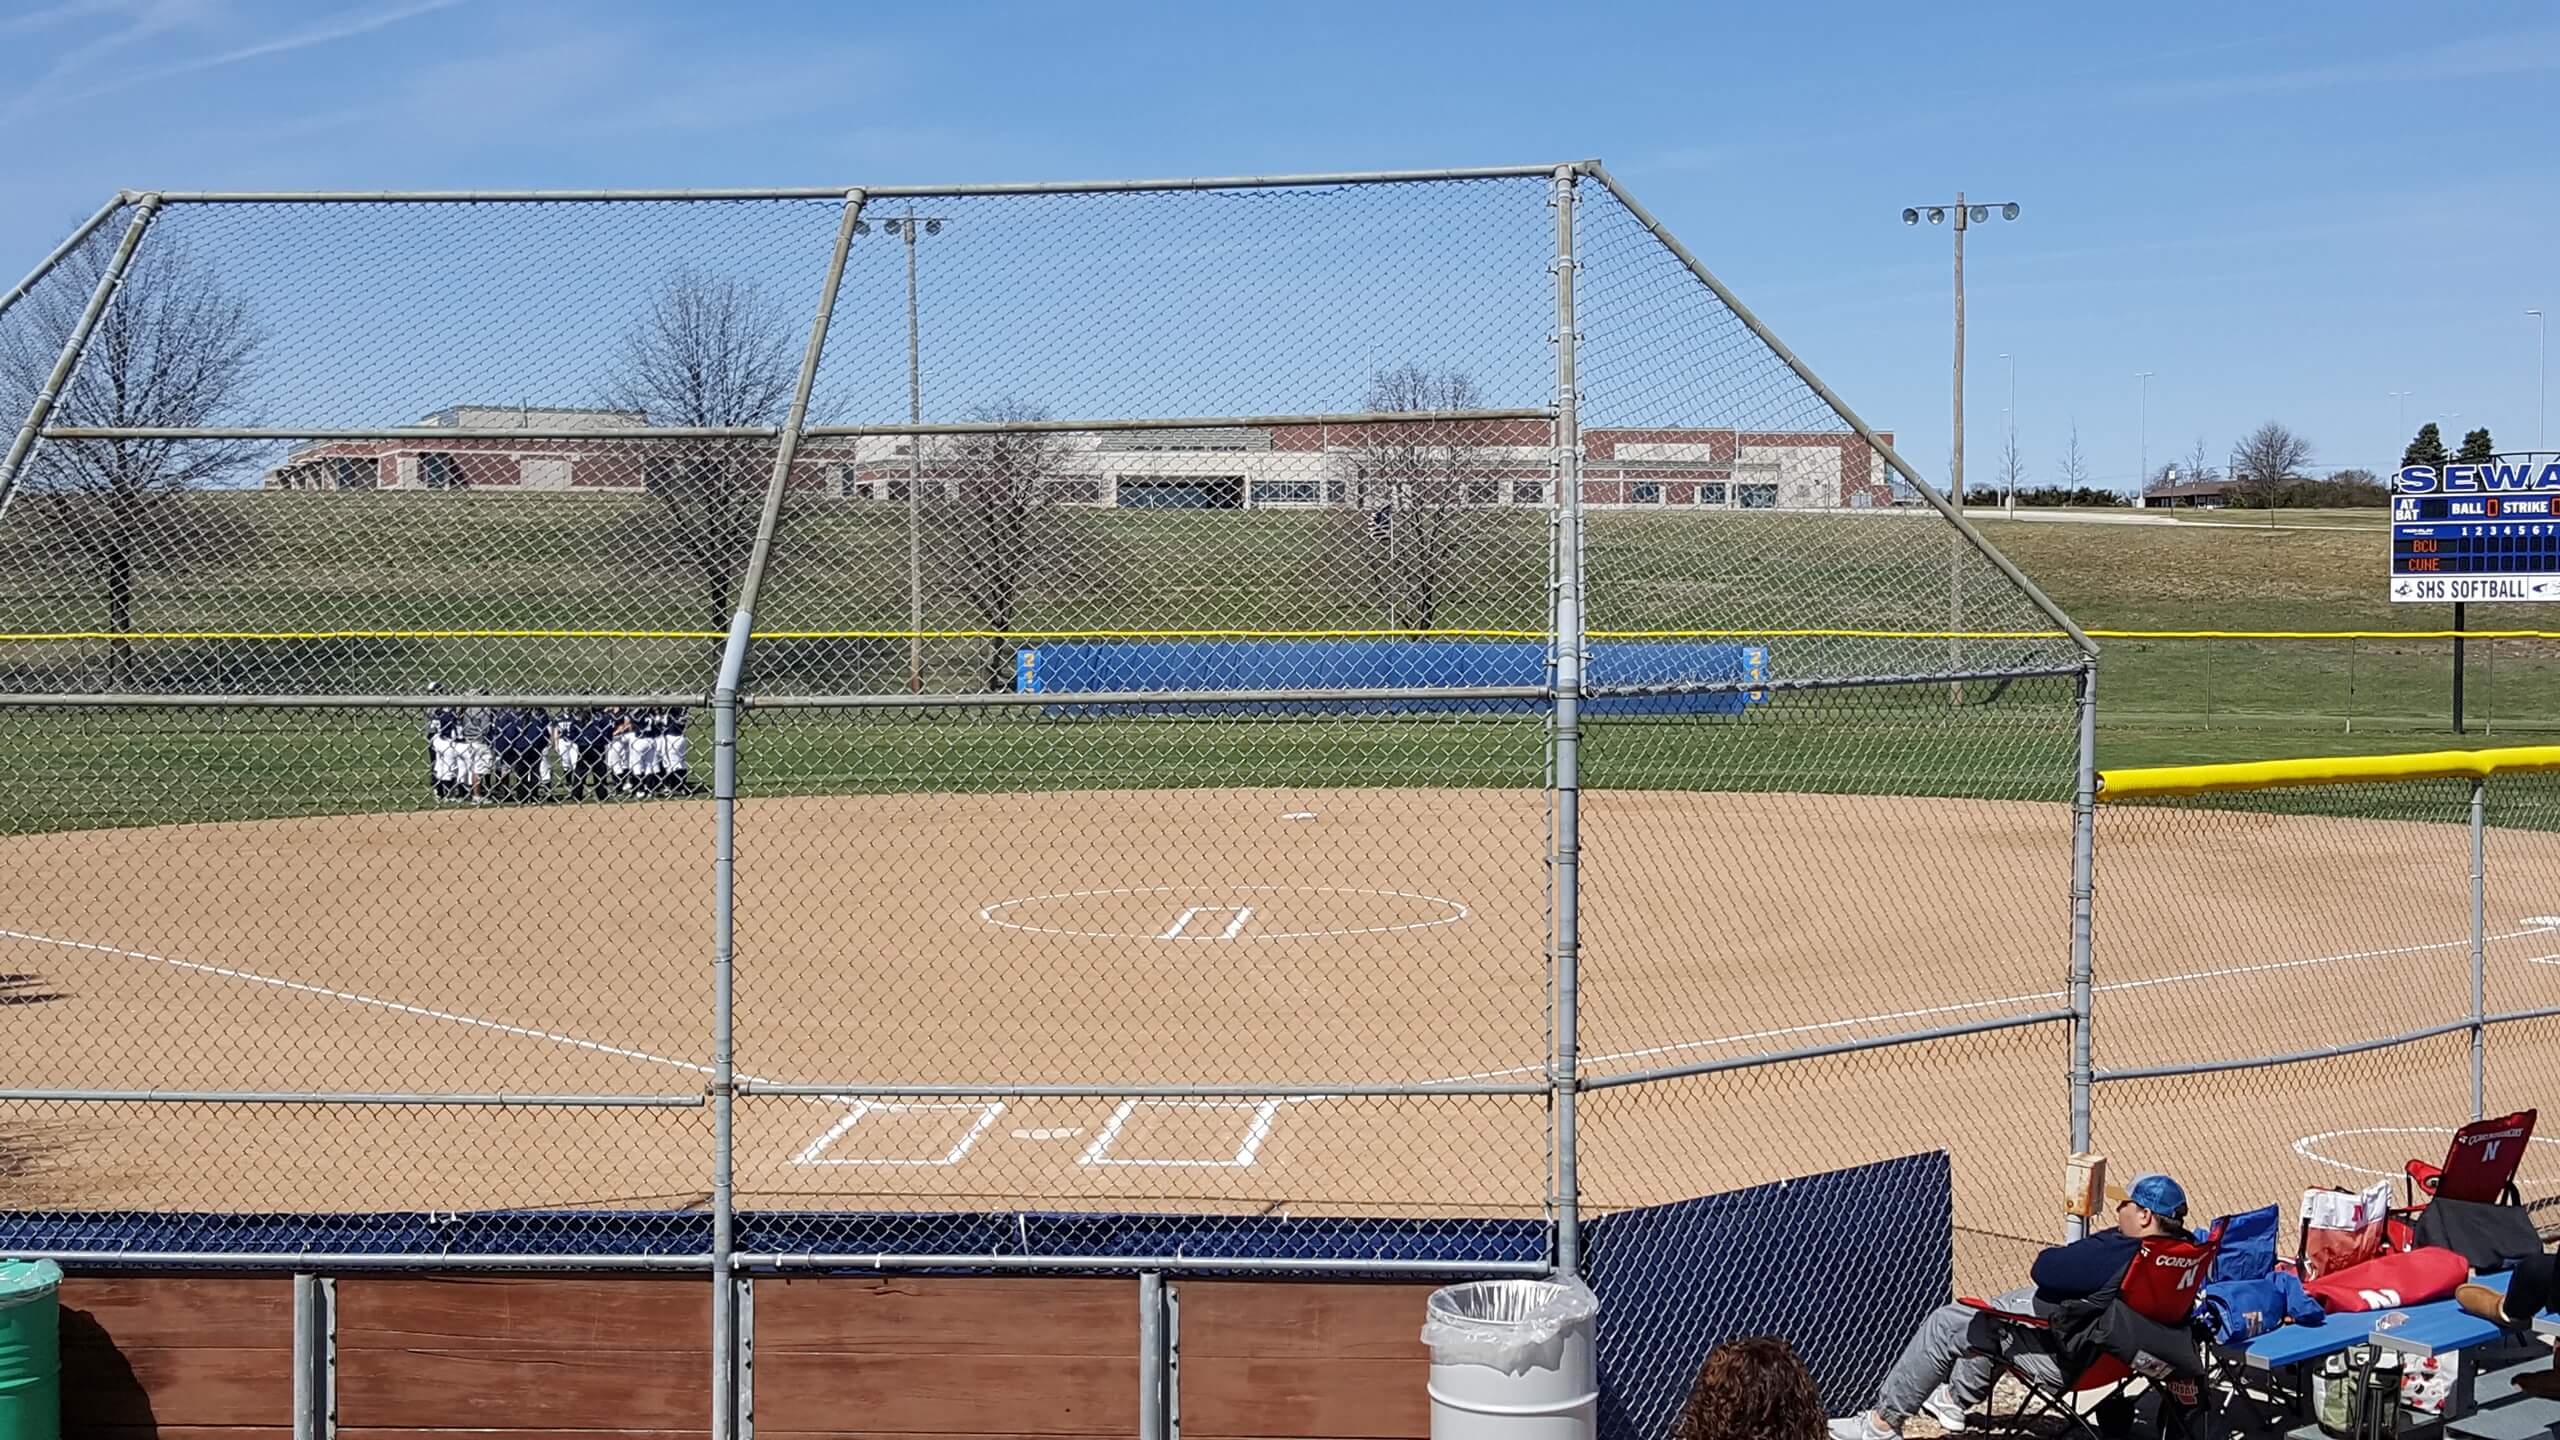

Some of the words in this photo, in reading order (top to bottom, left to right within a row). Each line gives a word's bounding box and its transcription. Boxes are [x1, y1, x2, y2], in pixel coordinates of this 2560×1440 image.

[2400, 499, 2416, 509] AT
[2452, 502, 2485, 514] BALL
[2503, 501, 2549, 513] STRIKE
[2395, 509, 2420, 521] BAT
[2461, 526, 2468, 536] 1
[2475, 525, 2483, 536] 2
[2490, 525, 2497, 536] 3
[2503, 525, 2511, 536] 4
[2518, 524, 2526, 535] 5
[2532, 525, 2540, 535] 6
[2546, 524, 2555, 535] 7
[2413, 539, 2437, 553] BCU
[2408, 558, 2440, 572] CUNE
[2416, 580, 2445, 599] SHS
[2451, 579, 2525, 598] SOFTBALL
[2481, 1140, 2501, 1162] N
[2176, 1264, 2200, 1291] N
[2357, 1288, 2401, 1311] N
